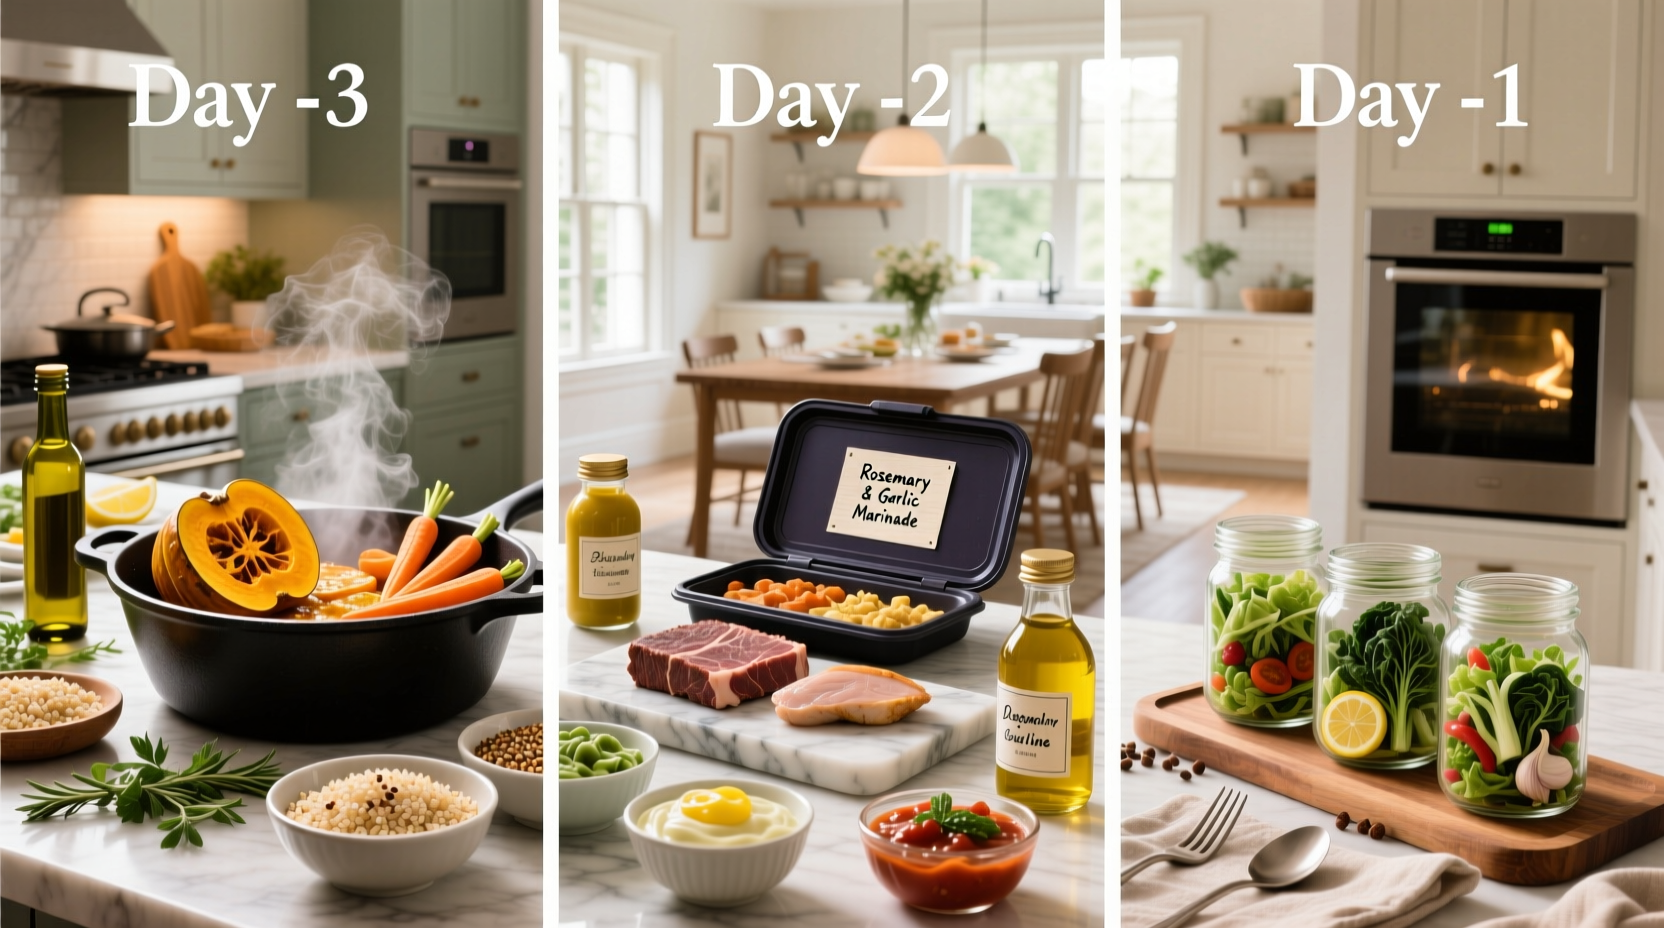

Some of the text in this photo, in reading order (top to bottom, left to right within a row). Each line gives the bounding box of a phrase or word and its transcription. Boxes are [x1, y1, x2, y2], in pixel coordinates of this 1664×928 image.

[860, 463, 931, 494] Rosemary
[861, 485, 919, 507] & Garlic
[852, 503, 918, 528] Marinade
